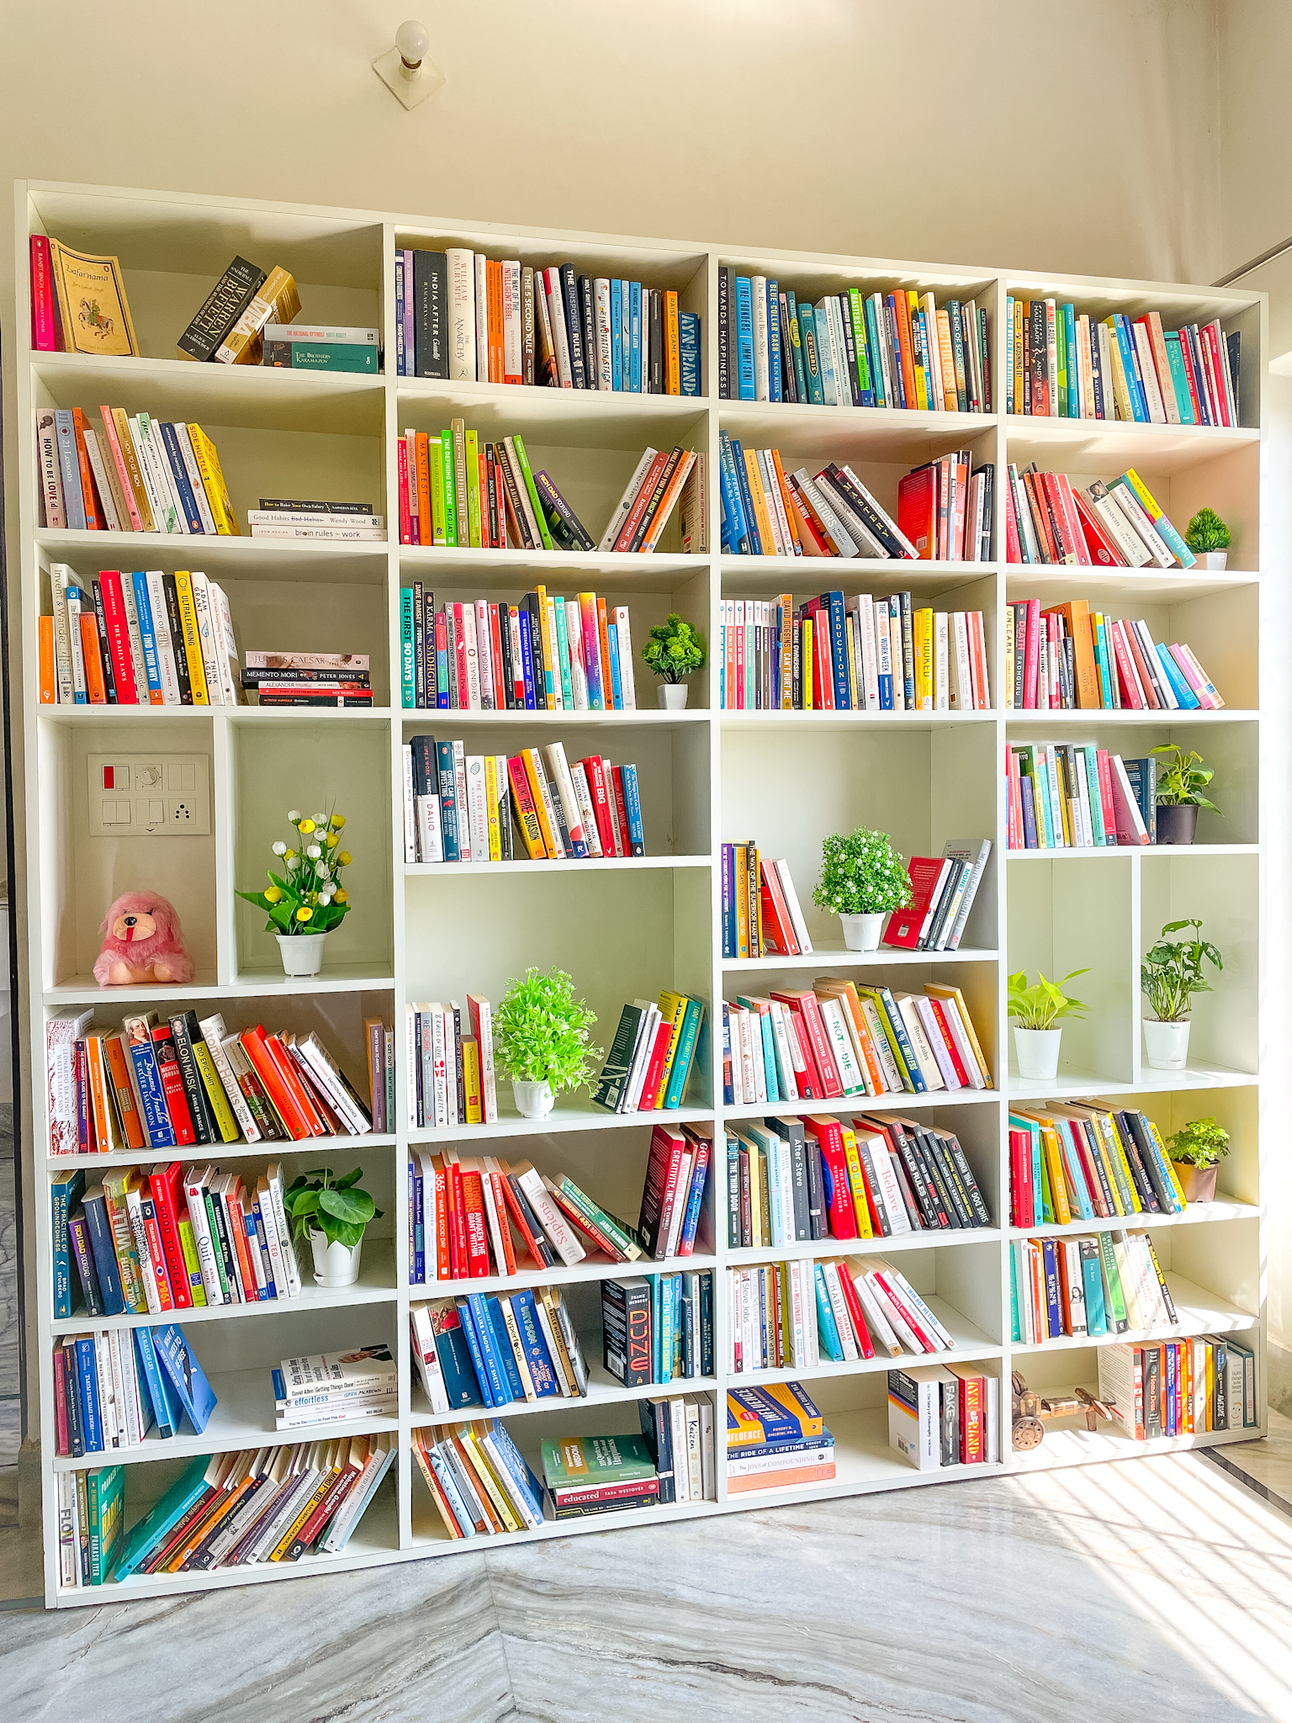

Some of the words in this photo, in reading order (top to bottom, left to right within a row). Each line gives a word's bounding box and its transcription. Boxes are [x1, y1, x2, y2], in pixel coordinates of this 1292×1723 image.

[37, 252, 45, 271] RANJIT
[504, 267, 512, 302] INTELLIGENT
[566, 269, 575, 286] THE
[199, 278, 238, 332] BUFFETT
[208, 286, 249, 338] WARREN
[505, 303, 513, 321] REBEL
[568, 287, 578, 331] UNSPOKEN
[719, 275, 727, 325] TOWARDS
[454, 317, 465, 362] ANARCHY
[681, 314, 695, 343] AYN
[572, 333, 581, 358] RULES
[939, 320, 955, 389] FACTFULNESS
[682, 352, 696, 392] RAND
[1067, 360, 1075, 390] greatness
[1144, 362, 1153, 389] MICHELLE
[1149, 391, 1158, 412] OBAMA
[62, 440, 70, 448] 21
[189, 425, 199, 443] SIDE
[195, 444, 208, 474] HUSTLE
[64, 450, 74, 483] Lessons
[419, 442, 428, 495] MANIFEST
[782, 474, 795, 493] START
[791, 491, 803, 507] WITH
[799, 504, 811, 520] WHY
[1027, 482, 1036, 495] YOU
[1030, 495, 1038, 508] CAN
[631, 497, 647, 521] RHONDA
[801, 477, 837, 528] INNOVATORS
[842, 481, 890, 538] MASTERY
[1101, 499, 1121, 528] Einstein
[624, 520, 639, 538] BYRNE
[194, 586, 203, 613] GRANT
[403, 596, 411, 614] THE
[783, 600, 791, 619] DAVID
[878, 603, 887, 615] THE
[113, 623, 121, 639] THE
[404, 615, 412, 641] FIRST
[426, 605, 434, 635] KARMA
[880, 615, 888, 637] 4-HOUR
[404, 642, 412, 656] 90
[880, 637, 889, 656] WORK
[1017, 620, 1026, 651] DEATH
[116, 639, 124, 661] DAILY
[1113, 631, 1121, 643] EGO
[1121, 660, 1131, 679] ENEMY
[204, 660, 213, 685] AGAIN
[404, 656, 412, 681] DAYS
[426, 644, 435, 698] SADHGURU
[882, 656, 890, 673] WEEK
[1015, 655, 1023, 696] SADHGURU
[784, 690, 791, 699] ME
[596, 787, 606, 805] BIG
[426, 803, 435, 831] DALIO
[750, 871, 756, 880] OF
[957, 868, 971, 894] MONEY
[949, 893, 962, 917] HACKS
[422, 1019, 431, 1053] REWORK
[686, 1022, 697, 1039] LITTLE
[808, 1008, 819, 1036] INTELLIGENT
[815, 1036, 826, 1058] INVESTOR
[913, 1024, 923, 1044] Steve
[919, 1045, 930, 1061] Jobs
[201, 1025, 225, 1068] Atomic
[683, 1040, 692, 1059] HABITS
[901, 1044, 918, 1071] LIMITLESS
[56, 1054, 64, 1079] WALTER
[136, 1061, 148, 1089] WALTER
[143, 1090, 156, 1126] ISAACSON
[222, 1067, 242, 1106] Habits
[235, 1108, 247, 1124] Clear
[696, 1142, 709, 1171] GOAL
[794, 1138, 803, 1161] After
[845, 1134, 855, 1152] THE
[795, 1162, 804, 1187] Steve
[849, 1155, 860, 1180] GOOD
[462, 1176, 474, 1213] ROBBINS
[471, 1175, 483, 1212] ANTHONY
[853, 1182, 864, 1201] LIFE
[881, 1170, 899, 1212] Behave
[1136, 1168, 1153, 1195] FASTLANE
[112, 1209, 132, 1252] WILL
[260, 1196, 270, 1219] TALK
[265, 1220, 275, 1241] LIKE
[270, 1243, 278, 1258] TED
[538, 1201, 568, 1246] Sapiens
[198, 1236, 211, 1263] Quit
[1108, 1247, 1116, 1270] ORIGIN
[158, 1280, 170, 1304] 1984
[814, 1270, 829, 1304] mindset
[830, 1284, 843, 1314] HABIT
[140, 1329, 148, 1342] THE
[142, 1342, 150, 1355] RULES
[505, 1313, 524, 1362] Hyperfocus
[146, 1360, 155, 1371] LIFE
[291, 1389, 304, 1397] David
[330, 1382, 344, 1390] Things
[967, 1381, 979, 1406] AYN
[734, 1388, 782, 1422] INFLUENCE
[687, 1420, 699, 1450] Kaizen
[968, 1421, 980, 1455] RAND
[337, 1470, 357, 1495] Mahatma
[421, 1466, 428, 1474] DO
[425, 1478, 436, 1494] TODAY
[323, 1494, 340, 1514] Gandhi
[563, 1490, 600, 1503] educated
[618, 1486, 644, 1494] WESTOVER
[296, 1502, 315, 1524] ANUBHAV
[60, 1508, 73, 1547] FLOW
[281, 1524, 299, 1546] AGRAWAL
